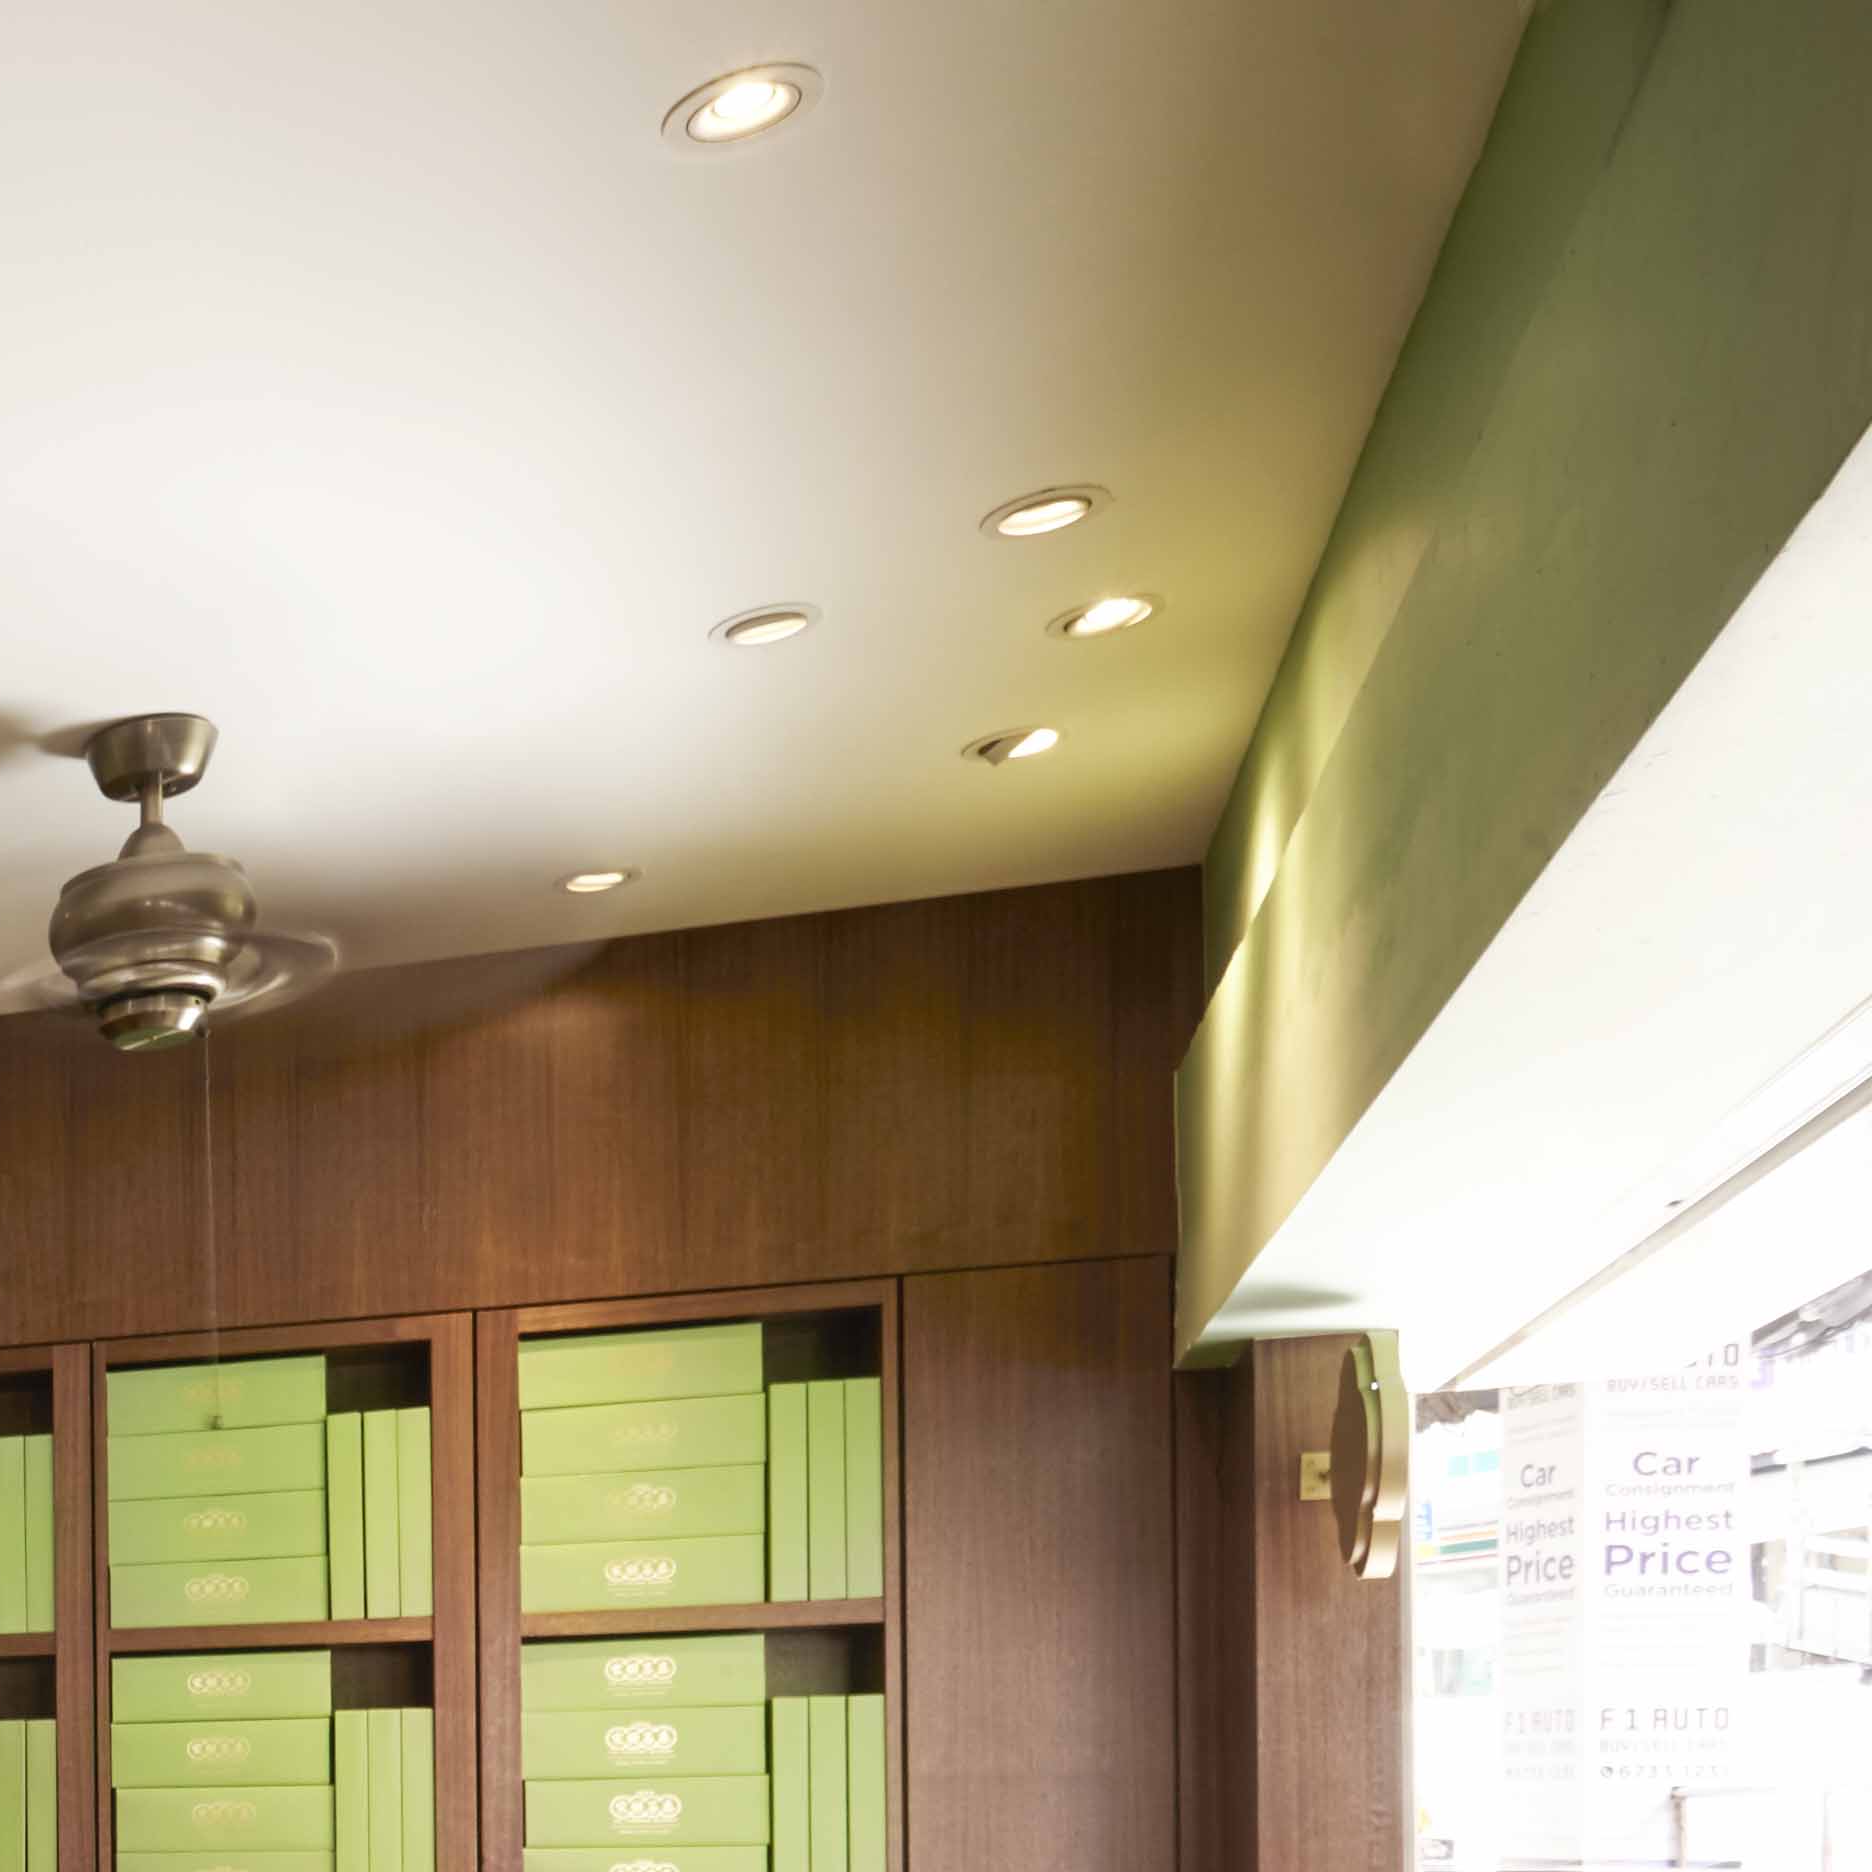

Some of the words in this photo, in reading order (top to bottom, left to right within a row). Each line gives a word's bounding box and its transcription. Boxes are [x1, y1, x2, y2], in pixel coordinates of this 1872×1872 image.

[1520, 1463, 1557, 1488] Car
[1633, 1451, 1701, 1476] Car
[1506, 1516, 1575, 1546] Highest
[1605, 1509, 1732, 1536] Highest
[1506, 1549, 1574, 1587] Price
[1605, 1541, 1732, 1576] Price
